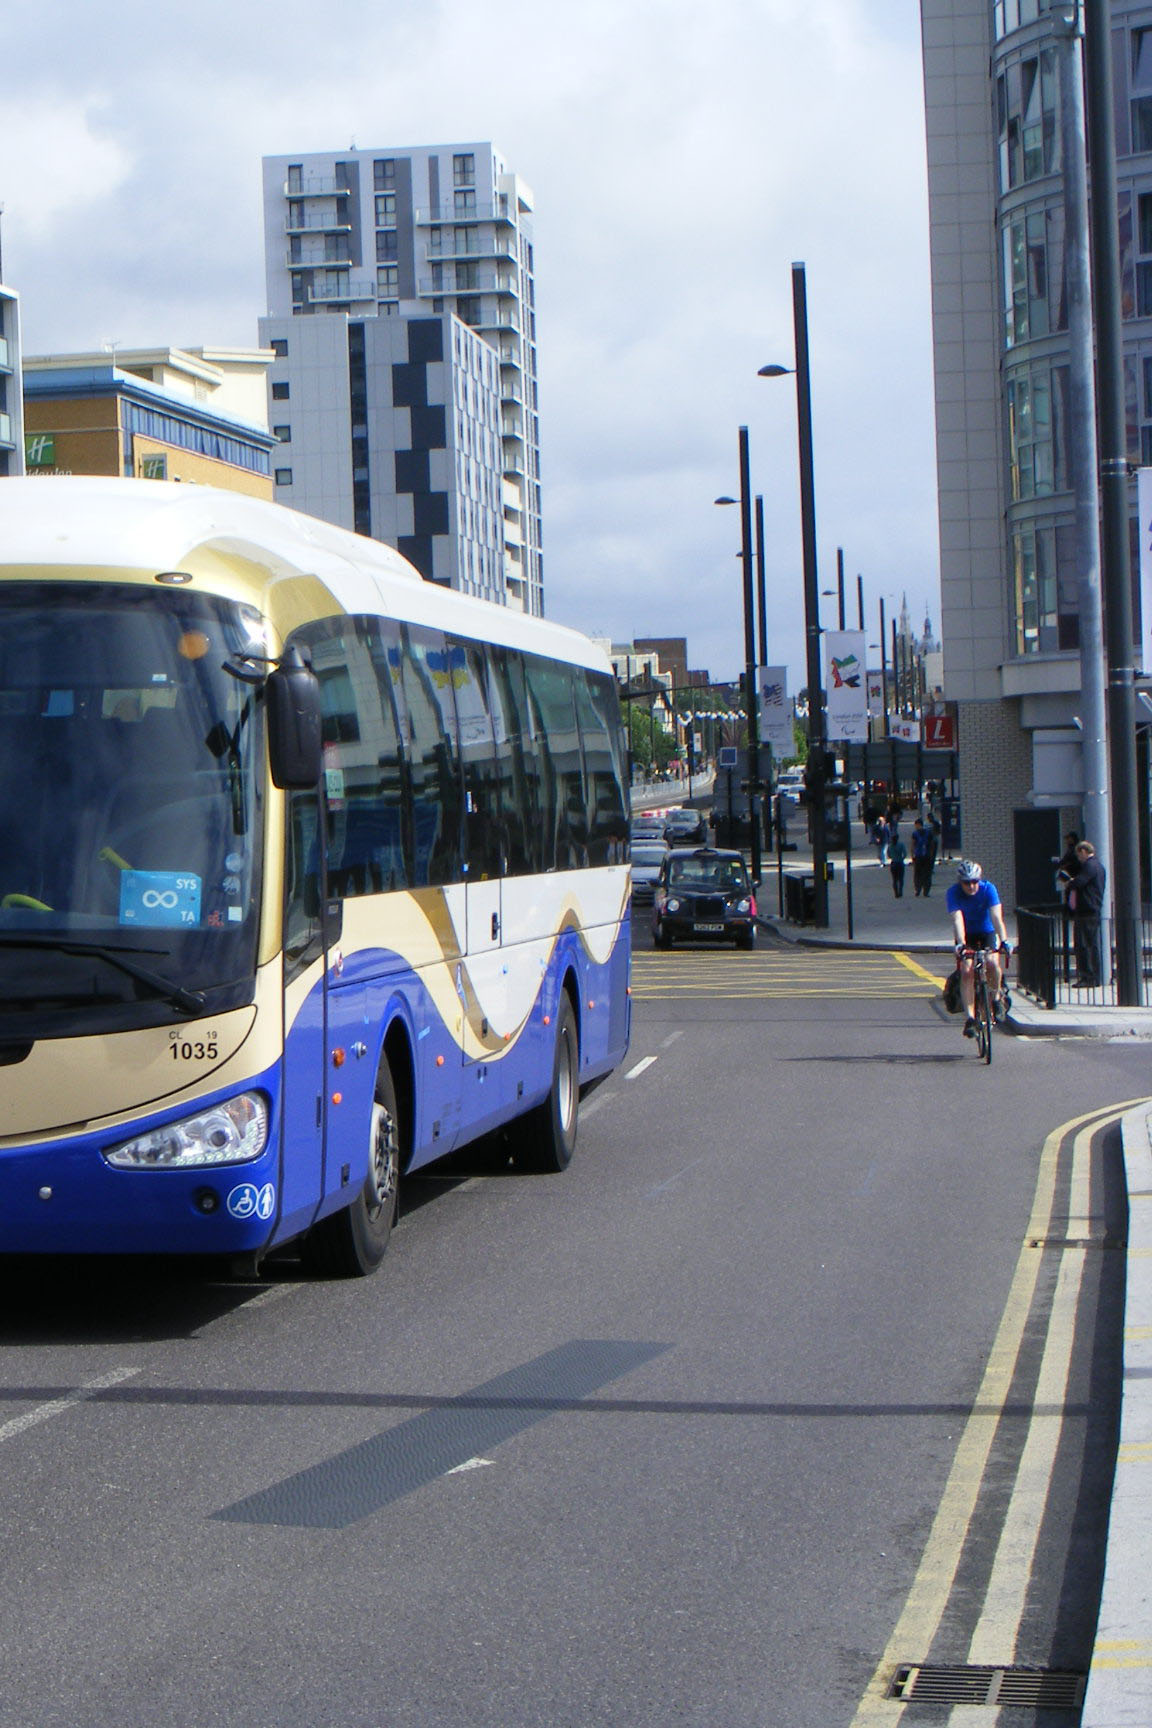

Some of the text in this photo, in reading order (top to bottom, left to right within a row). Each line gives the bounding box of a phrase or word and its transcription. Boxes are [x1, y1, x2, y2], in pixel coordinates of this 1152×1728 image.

[176, 879, 197, 890] SYS
[180, 911, 196, 922] TA
[169, 1031, 217, 1039] CL 19
[169, 1042, 218, 1059] 1035
